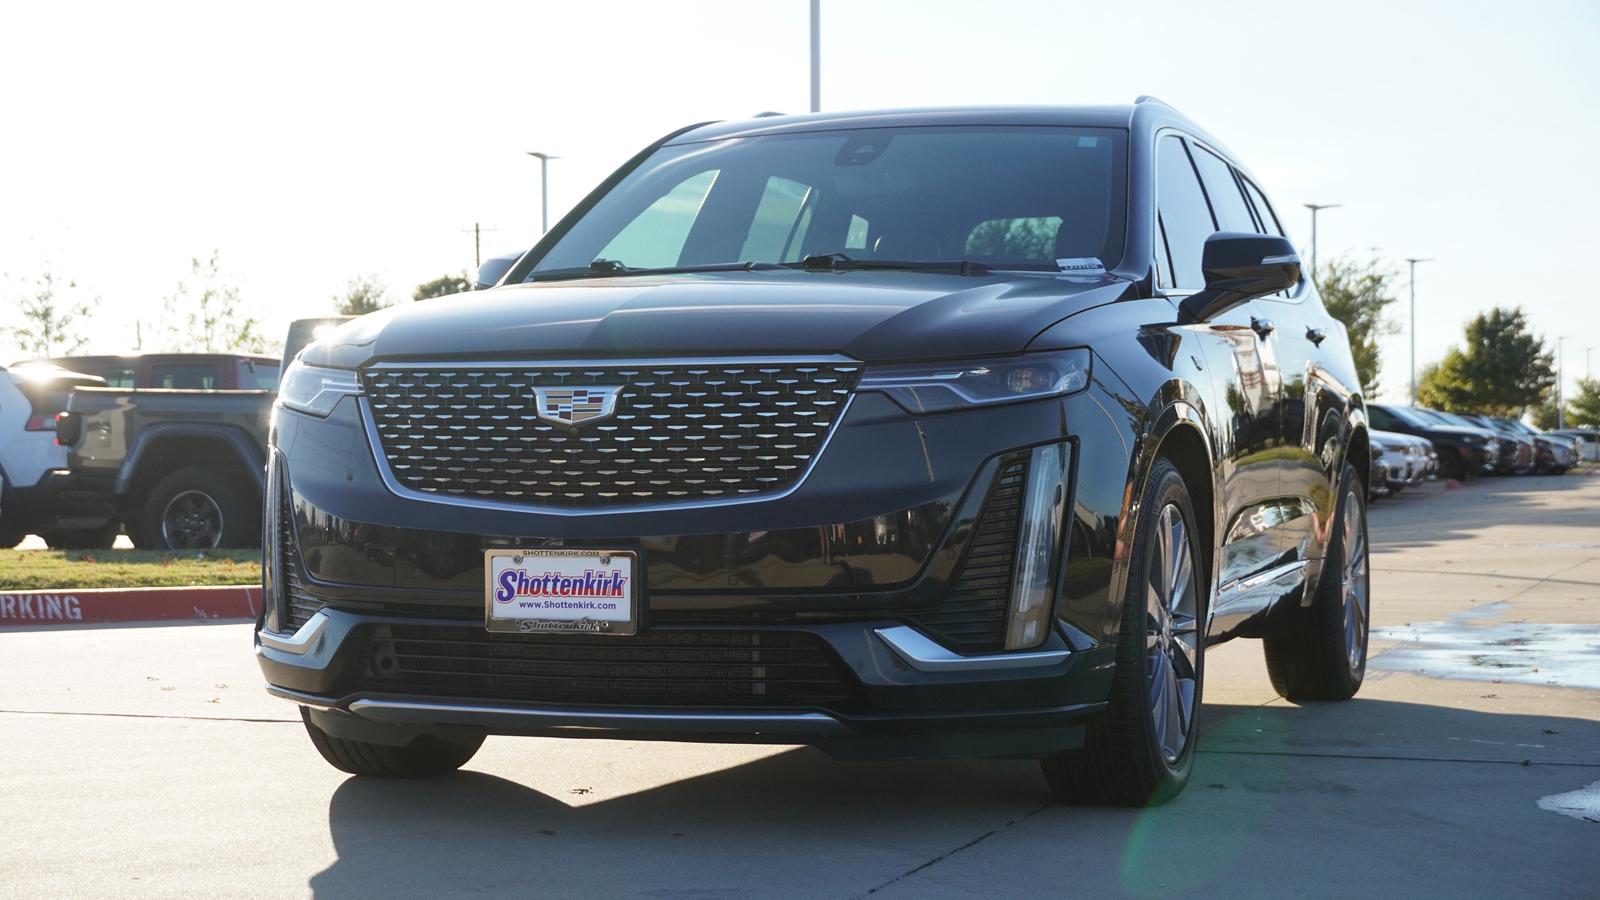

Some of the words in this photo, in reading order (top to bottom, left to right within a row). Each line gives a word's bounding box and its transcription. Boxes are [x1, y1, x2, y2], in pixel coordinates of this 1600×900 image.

[496, 569, 627, 603] Shottenkirk
[0, 594, 82, 619] RKING
[519, 601, 617, 610] www.Shottenkirk.com
[520, 620, 600, 632] Shottenkirk
